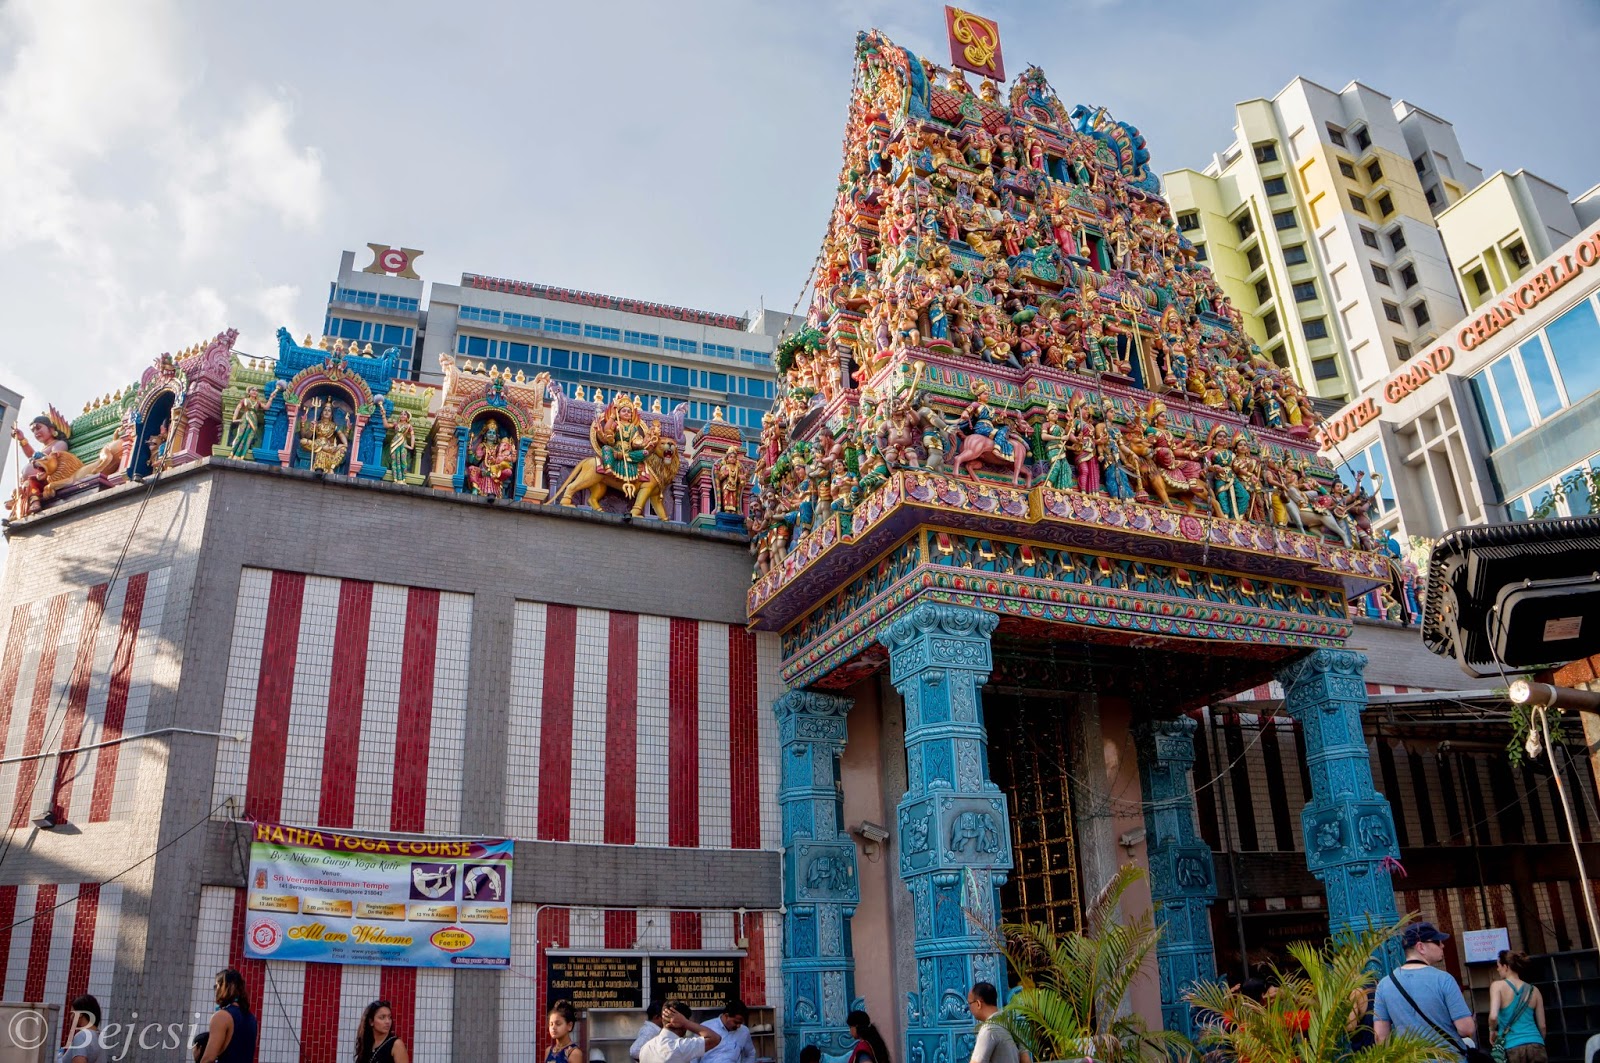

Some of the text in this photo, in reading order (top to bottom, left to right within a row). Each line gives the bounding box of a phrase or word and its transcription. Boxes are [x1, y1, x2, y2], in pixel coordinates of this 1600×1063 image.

[471, 275, 739, 330] HOTEL GRAND CHANCELLOR
[1319, 397, 1382, 452] HOTEL
[1383, 345, 1454, 404] GRAND
[257, 824, 471, 856] HATHA YOGA COURSE
[270, 850, 282, 861] By
[289, 852, 320, 866] Nikam
[322, 856, 351, 869] Guruji
[354, 859, 376, 871] Yoga
[378, 860, 400, 872] Kutir
[273, 874, 390, 890] Sri Veeramakaliamman Temple
[321, 869, 342, 877] Venue:
[289, 884, 318, 892] Serangoon
[287, 922, 327, 941] All
[323, 931, 348, 942] are
[351, 924, 414, 946] Welcome
[438, 939, 453, 947] Fee:
